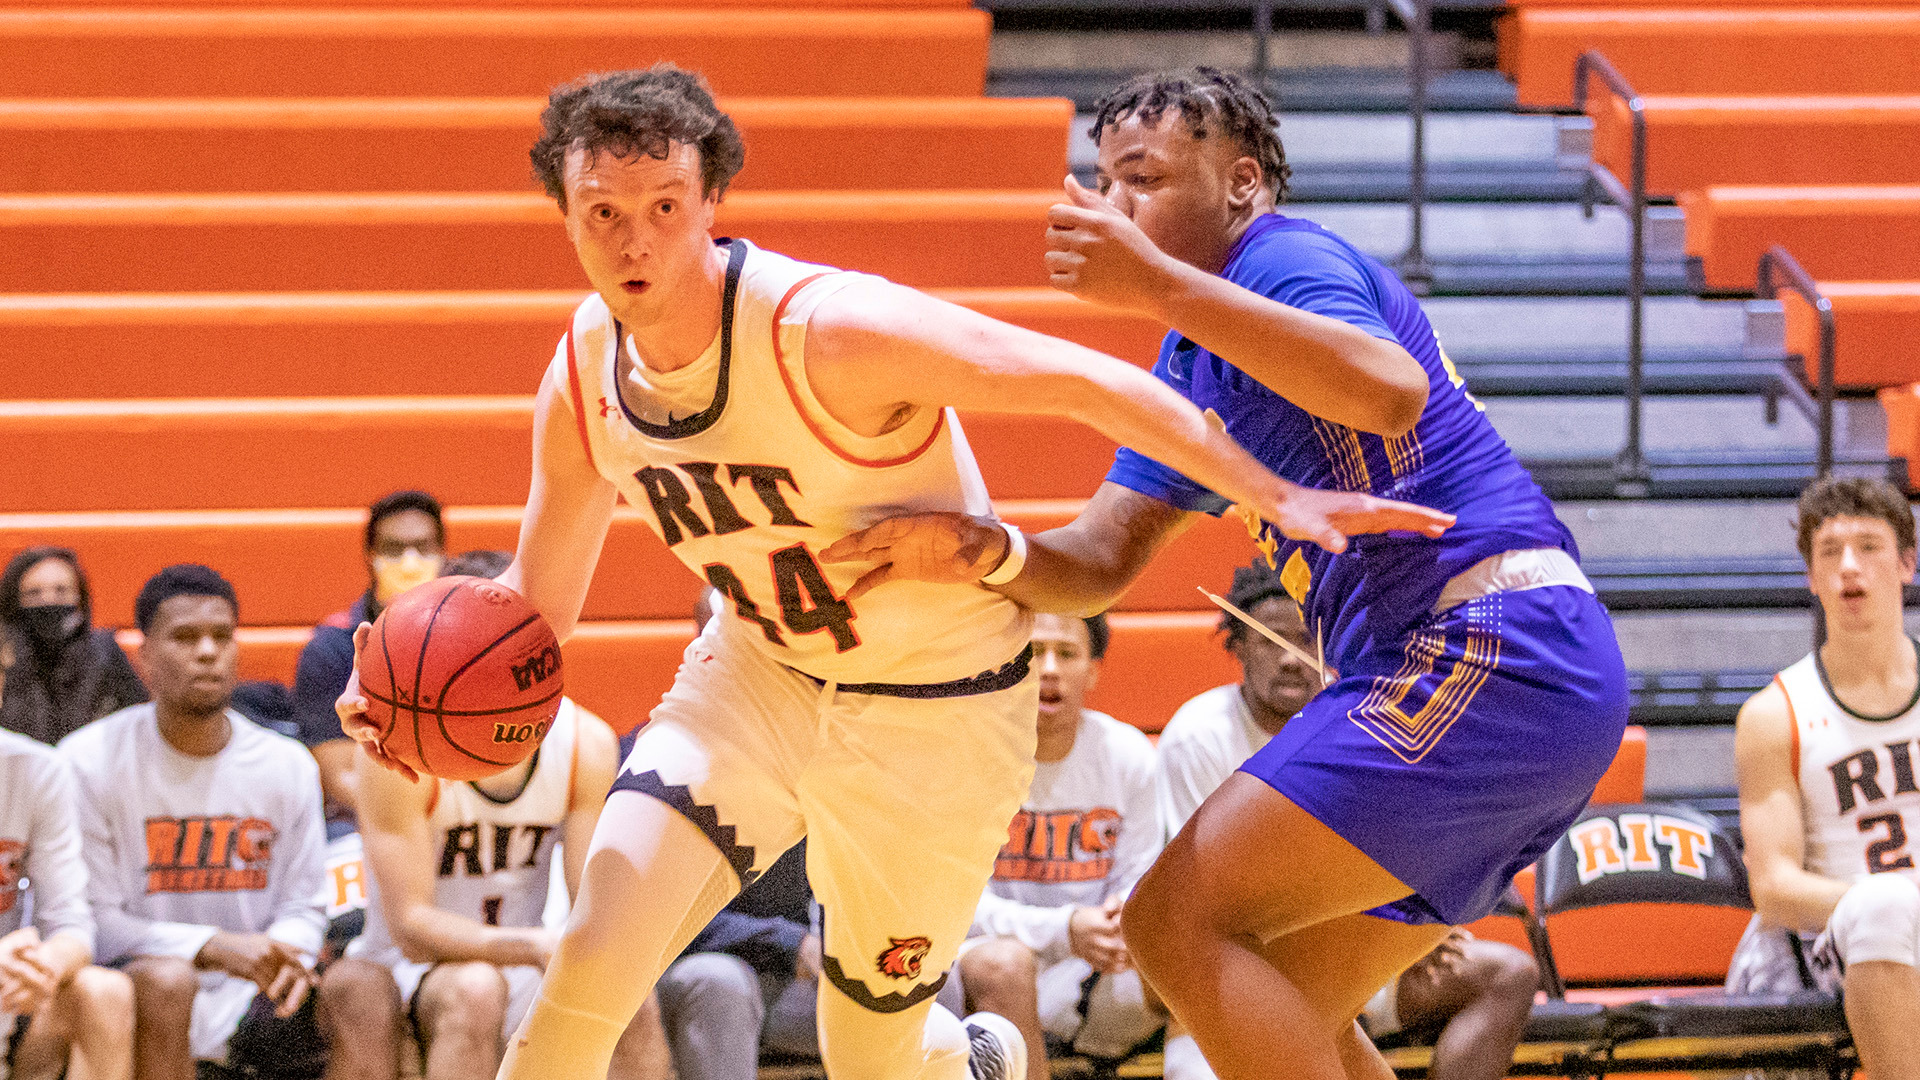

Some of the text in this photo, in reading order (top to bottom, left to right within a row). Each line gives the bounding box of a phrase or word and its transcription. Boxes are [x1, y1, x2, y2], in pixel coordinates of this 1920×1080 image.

[633, 461, 815, 547] RIT
[702, 541, 862, 654] 14
[511, 643, 562, 692] CAA
[1827, 738, 1920, 817] RI
[438, 823, 552, 878] RIT
[1570, 814, 1714, 885] RIT
[1856, 810, 1916, 875] 2
